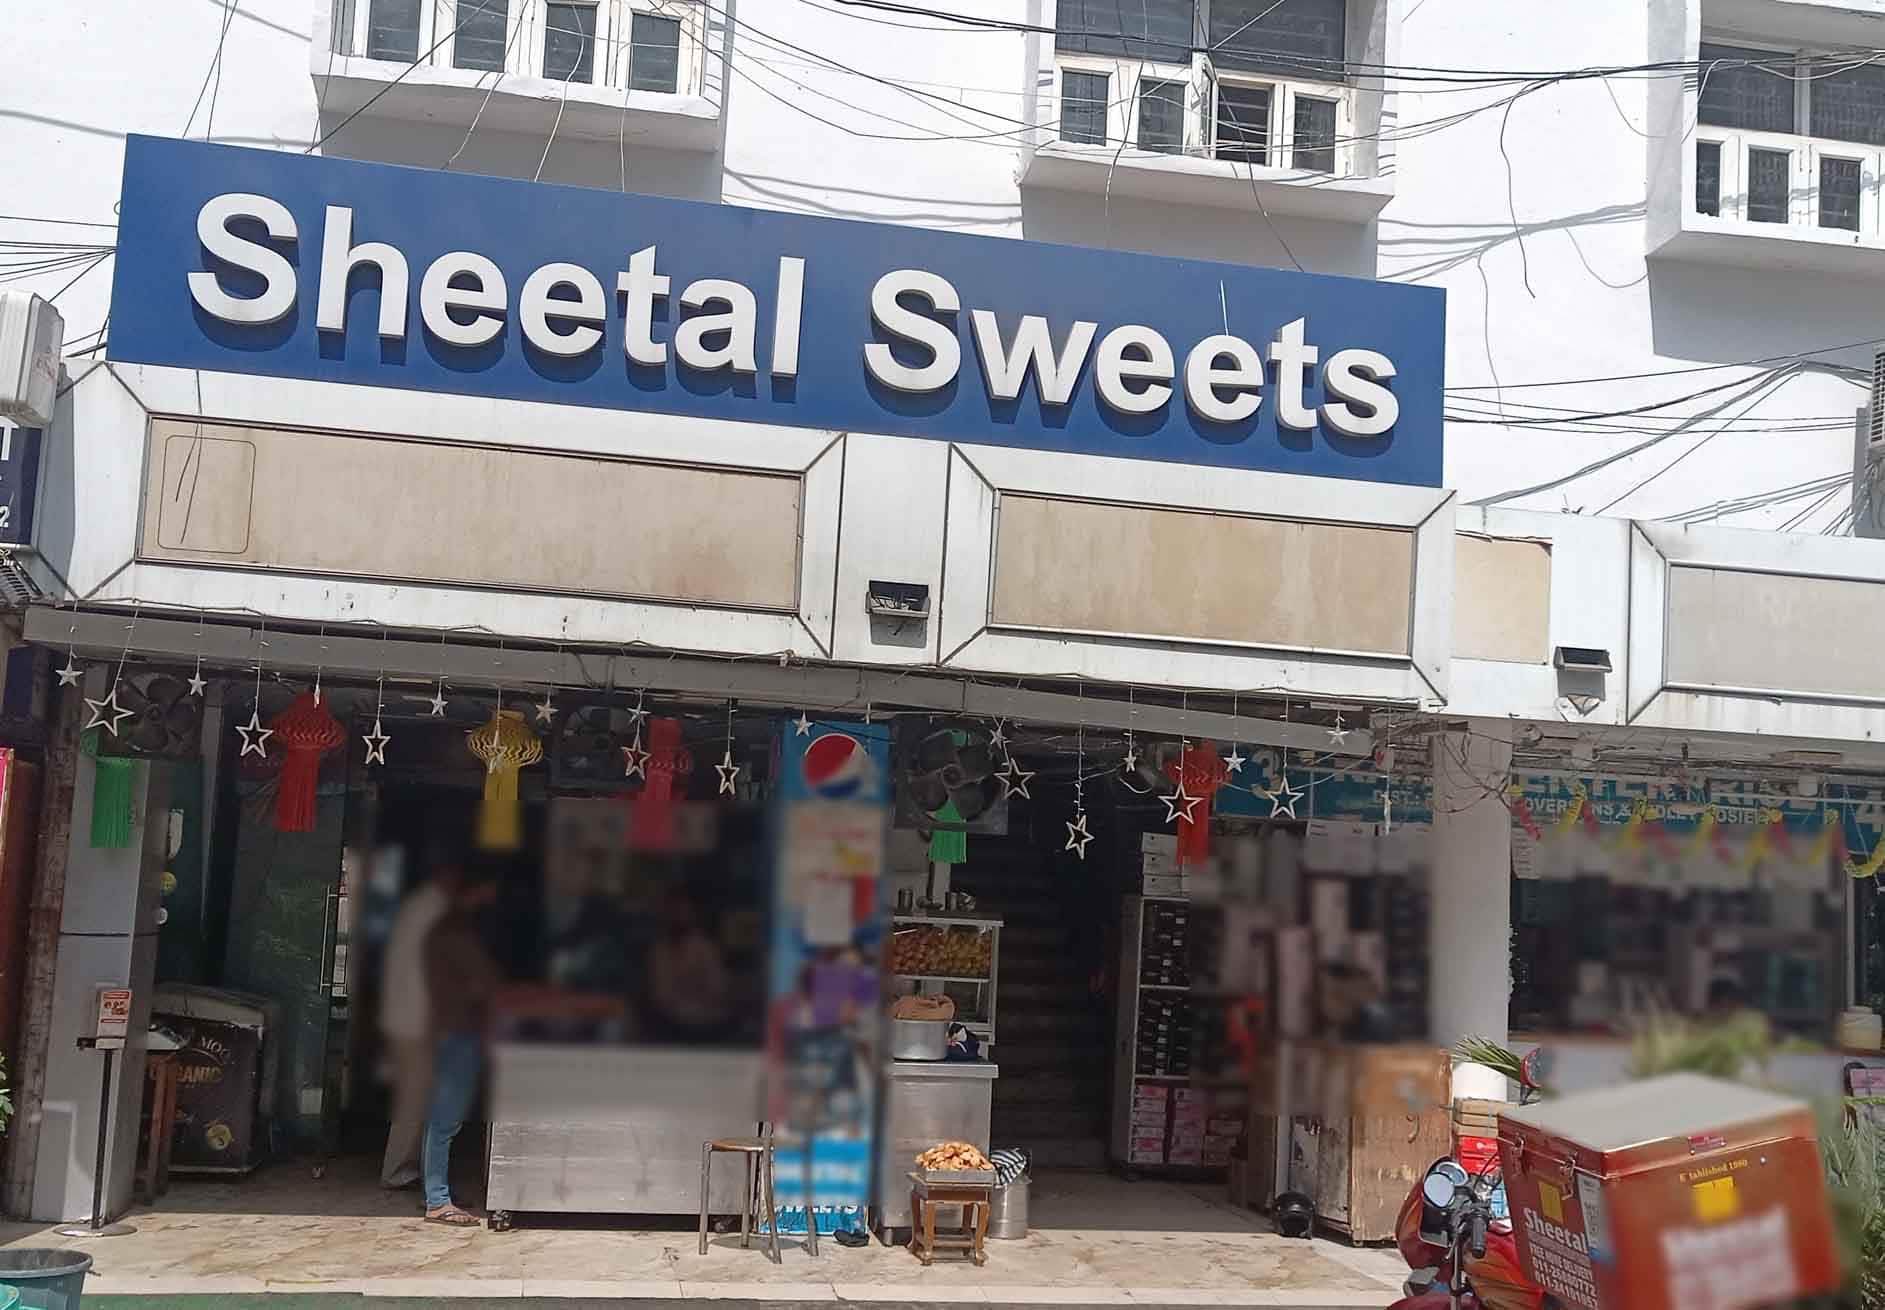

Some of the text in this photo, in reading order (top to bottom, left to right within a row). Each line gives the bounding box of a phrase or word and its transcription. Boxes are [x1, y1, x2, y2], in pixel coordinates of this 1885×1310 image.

[187, 192, 1400, 437] Sheetal Sweets
[1523, 1207, 1589, 1254] Sheetal
